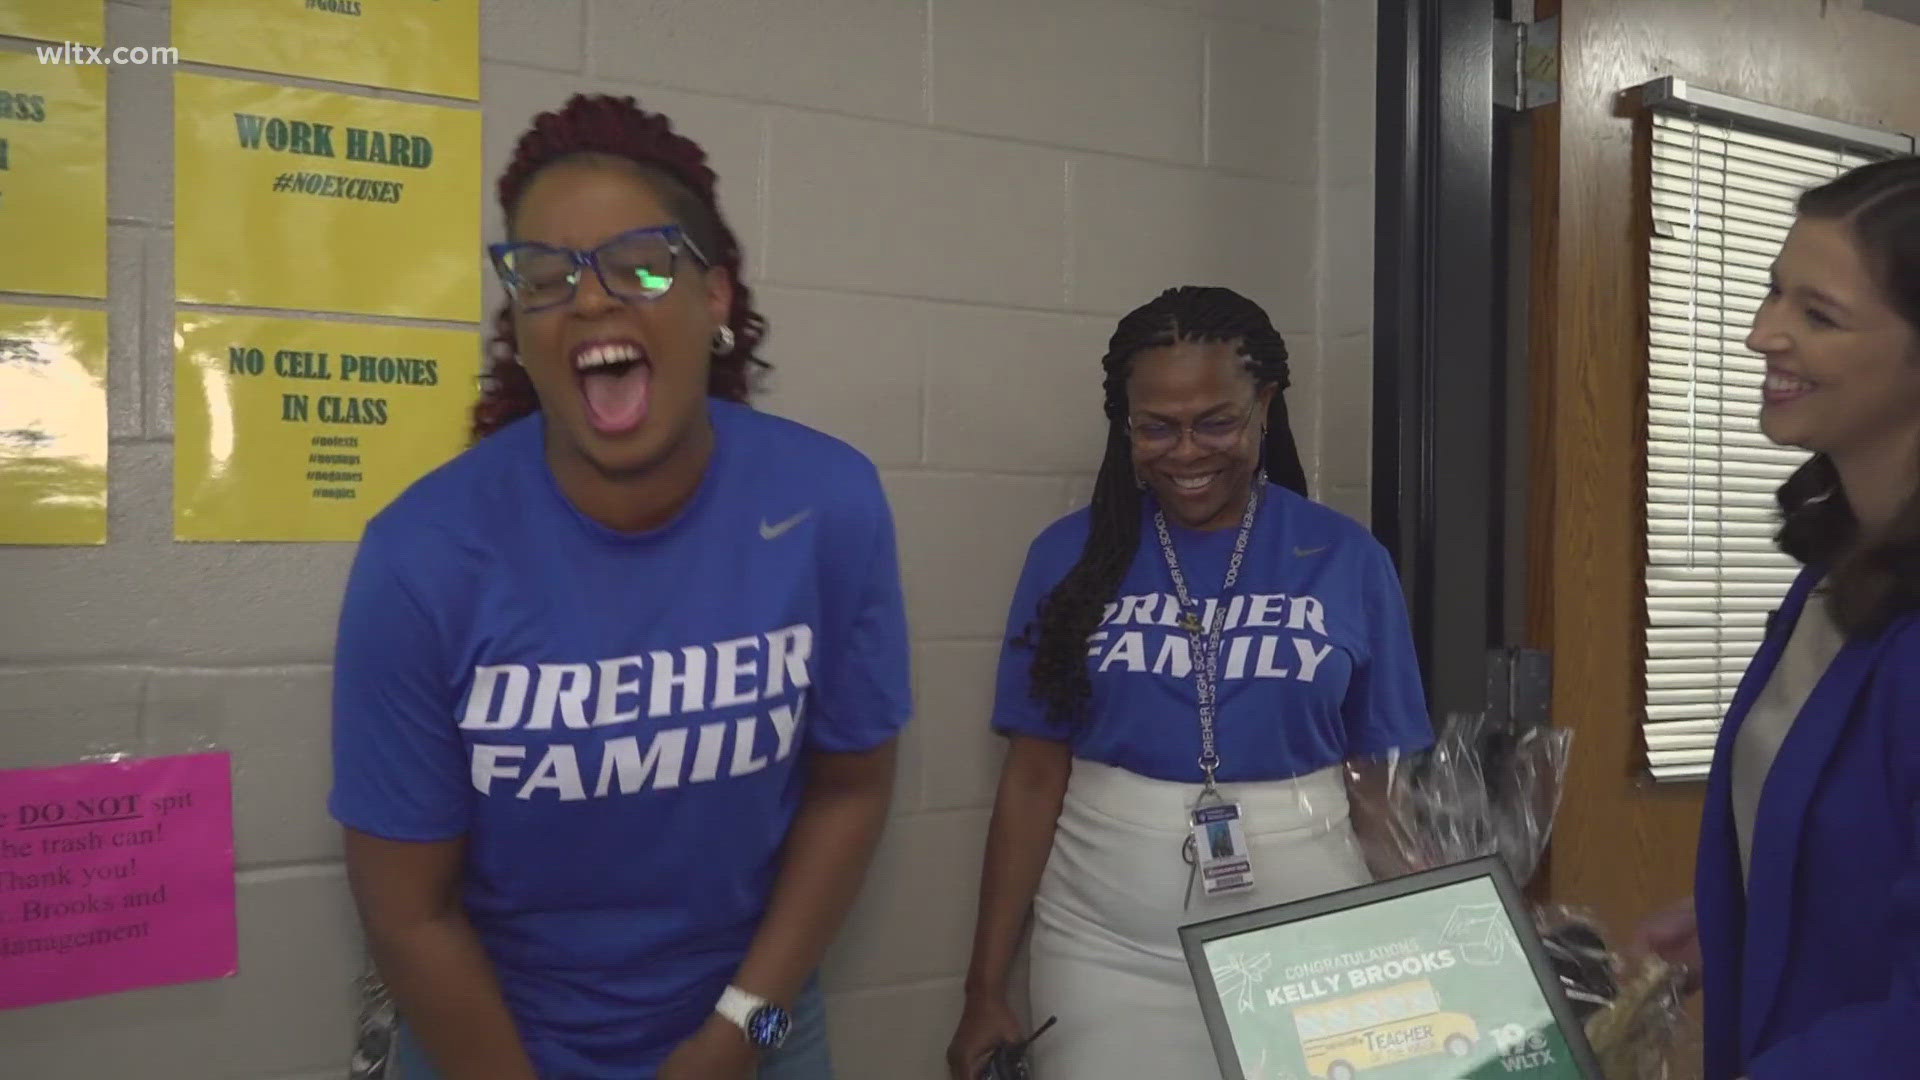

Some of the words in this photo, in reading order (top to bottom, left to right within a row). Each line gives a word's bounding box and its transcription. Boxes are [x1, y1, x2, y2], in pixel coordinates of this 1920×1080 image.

[233, 112, 336, 159] WORK
[345, 126, 434, 169] HARD
[272, 171, 403, 204] #NOEXCUSES
[228, 346, 265, 377] NO
[274, 349, 332, 381] CELL
[340, 353, 438, 387] PHONES
[281, 393, 309, 423] IN
[317, 395, 389, 426] CLASS
[1223, 553, 1244, 590] SCHOOL
[1189, 631, 1206, 671] SCHOO
[458, 623, 814, 731] DREHER
[1196, 673, 1210, 704] HIGH
[470, 690, 807, 801] FAMILY
[1199, 706, 1215, 758] DREHER
[19, 803, 65, 827] DO
[76, 794, 142, 818] NOT
[152, 791, 194, 816] spit
[0, 838, 33, 859] he
[43, 830, 102, 855] trash
[112, 823, 163, 848] can!
[82, 858, 137, 888] you!
[22, 893, 115, 922] Brooks
[123, 885, 166, 908] and
[0, 922, 150, 959] anagement
[1265, 973, 1342, 1007] KELLY
[1347, 949, 1457, 989] BROOKS
[1285, 938, 1420, 981] CONGRATULATIONS
[1501, 1048, 1557, 1073] WLTX
